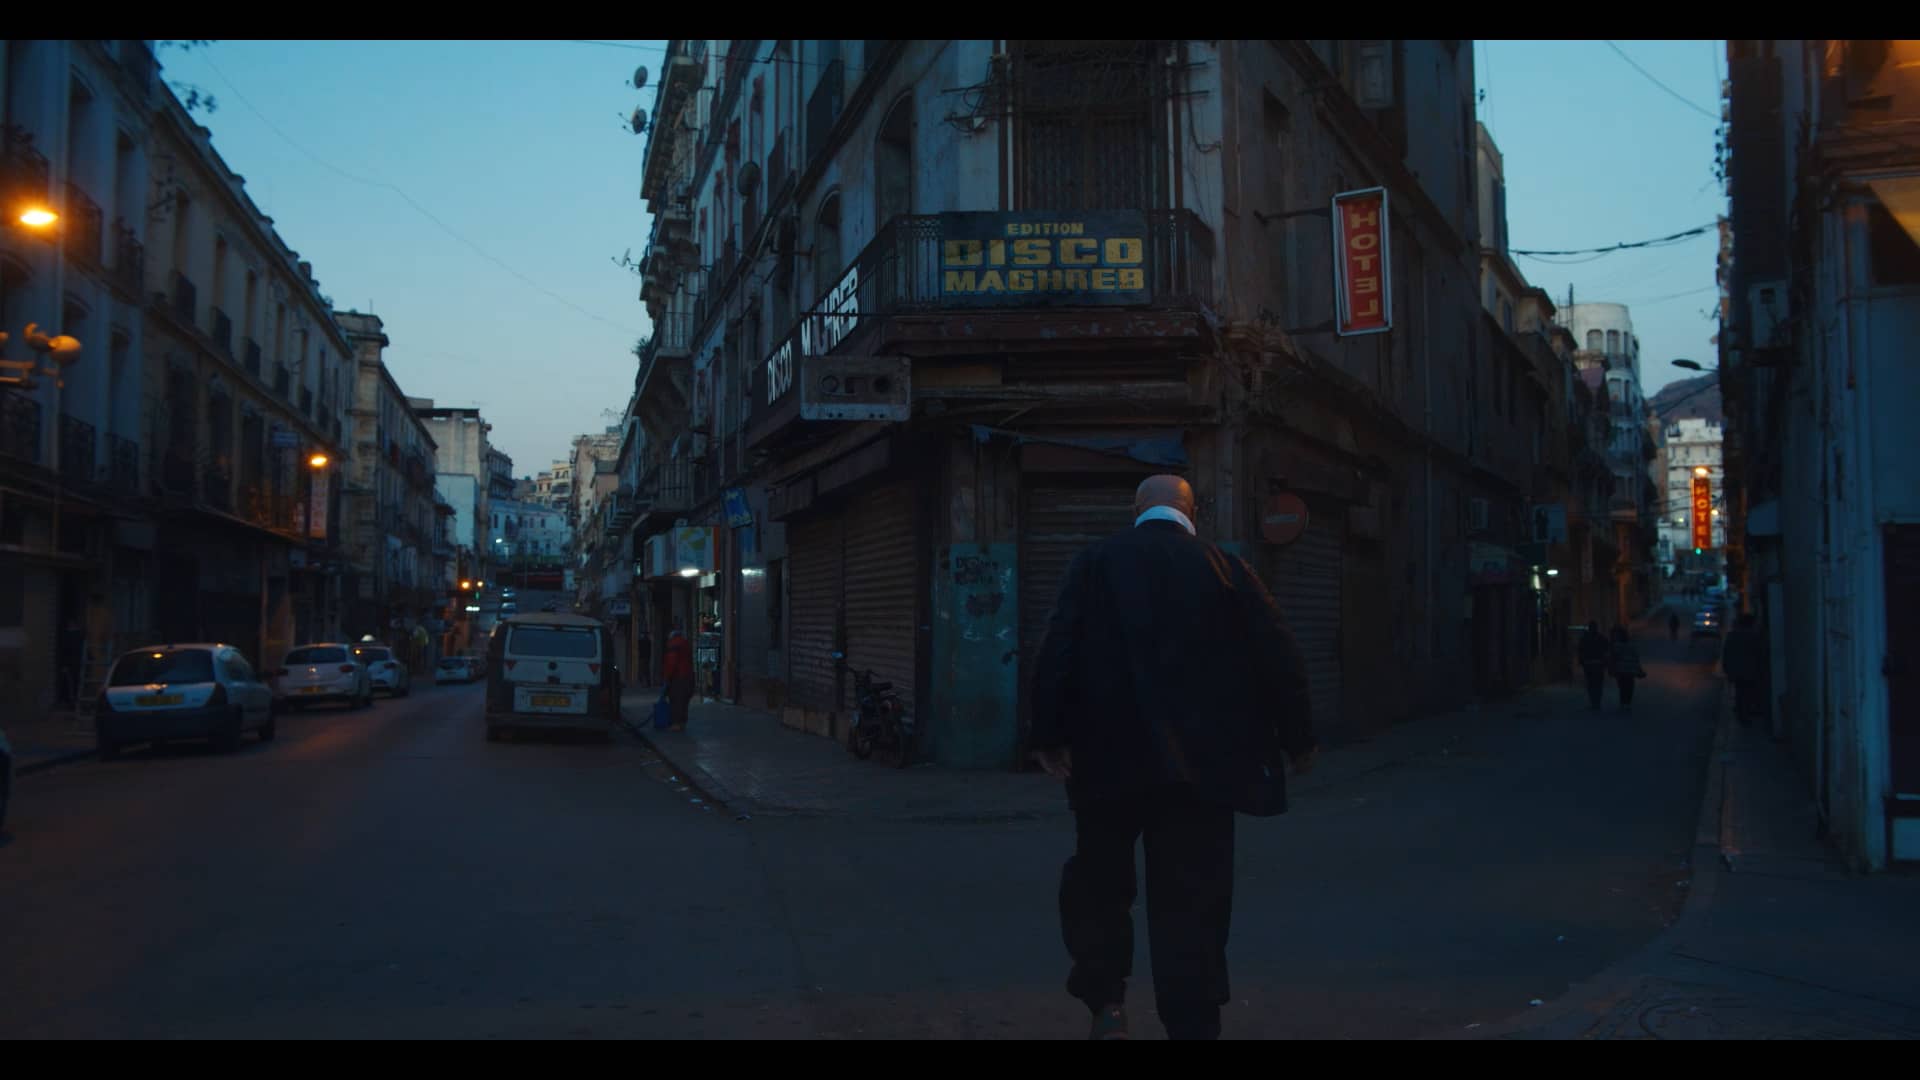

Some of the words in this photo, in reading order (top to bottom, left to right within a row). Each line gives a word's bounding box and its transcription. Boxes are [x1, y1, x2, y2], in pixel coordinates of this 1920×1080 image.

[1007, 223, 1084, 235] EDITION
[944, 238, 1143, 266] DISCO
[944, 268, 1144, 291] MAGHREB
